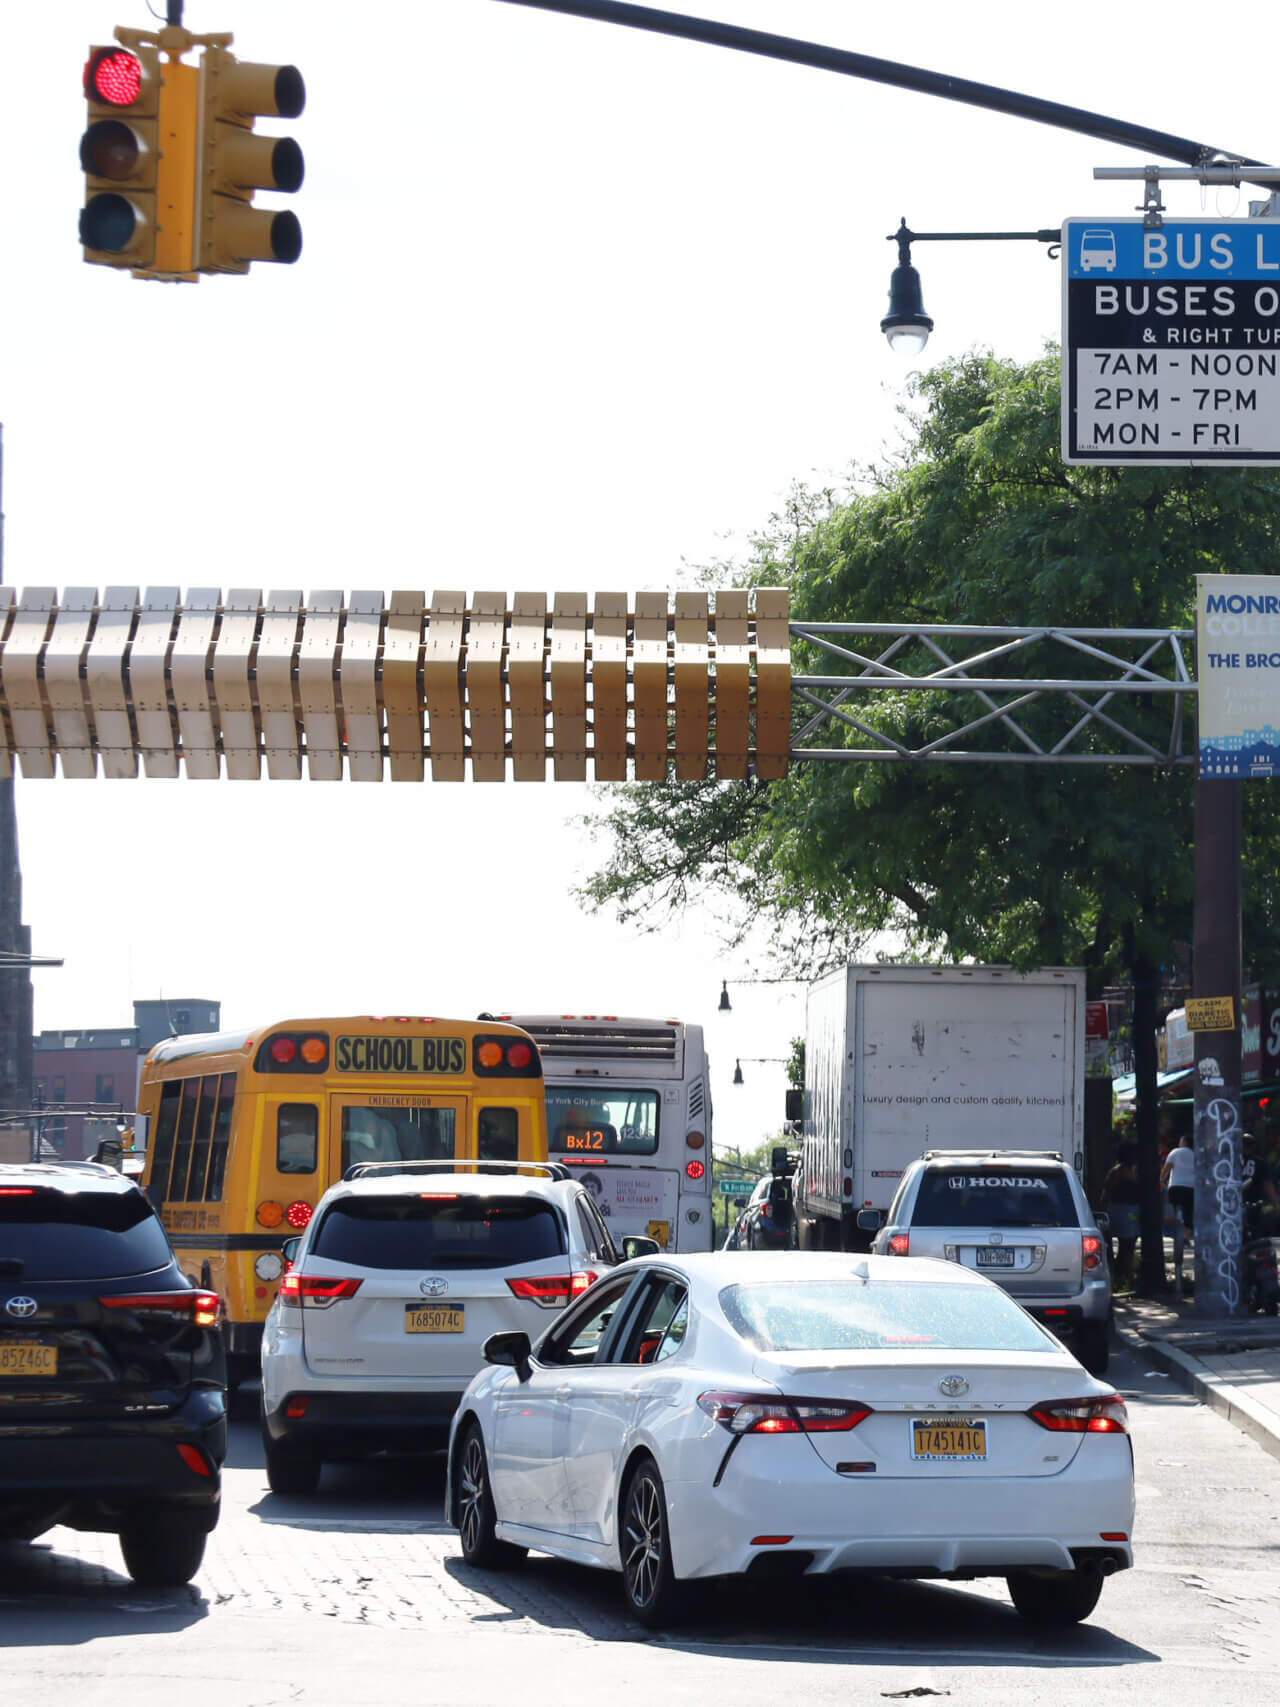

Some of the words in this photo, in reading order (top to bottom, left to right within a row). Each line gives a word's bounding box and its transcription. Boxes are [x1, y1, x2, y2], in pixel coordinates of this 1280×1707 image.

[1143, 233, 1234, 270] BUS
[1095, 285, 1236, 316] BUSES
[1142, 328, 1157, 344] &
[1167, 327, 1233, 344] RIGHT
[1094, 353, 1158, 376] 7AM
[1191, 353, 1277, 376] NOON
[1094, 388, 1159, 410] 2PM
[1192, 389, 1257, 411] 7PM
[1092, 423, 1160, 445] MON
[1193, 423, 1240, 445] FRI
[1207, 653, 1241, 668] THE
[338, 1038, 418, 1071] SCHOOL
[423, 1039, 463, 1072] BUS
[368, 1097, 409, 1106] EMERGENCY
[413, 1097, 431, 1106] DOOR
[555, 1096, 571, 1104] York
[573, 1096, 588, 1106] City
[862, 1095, 892, 1105] Luxury
[895, 1095, 928, 1106] design
[931, 1095, 950, 1104] and
[953, 1096, 988, 1105] custom
[991, 1096, 1023, 1106] quality
[567, 1130, 604, 1150] Bx12
[969, 1177, 1048, 1188] HONDA
[410, 1311, 461, 1328] T685074C
[918, 1431, 981, 1451] T745141C
